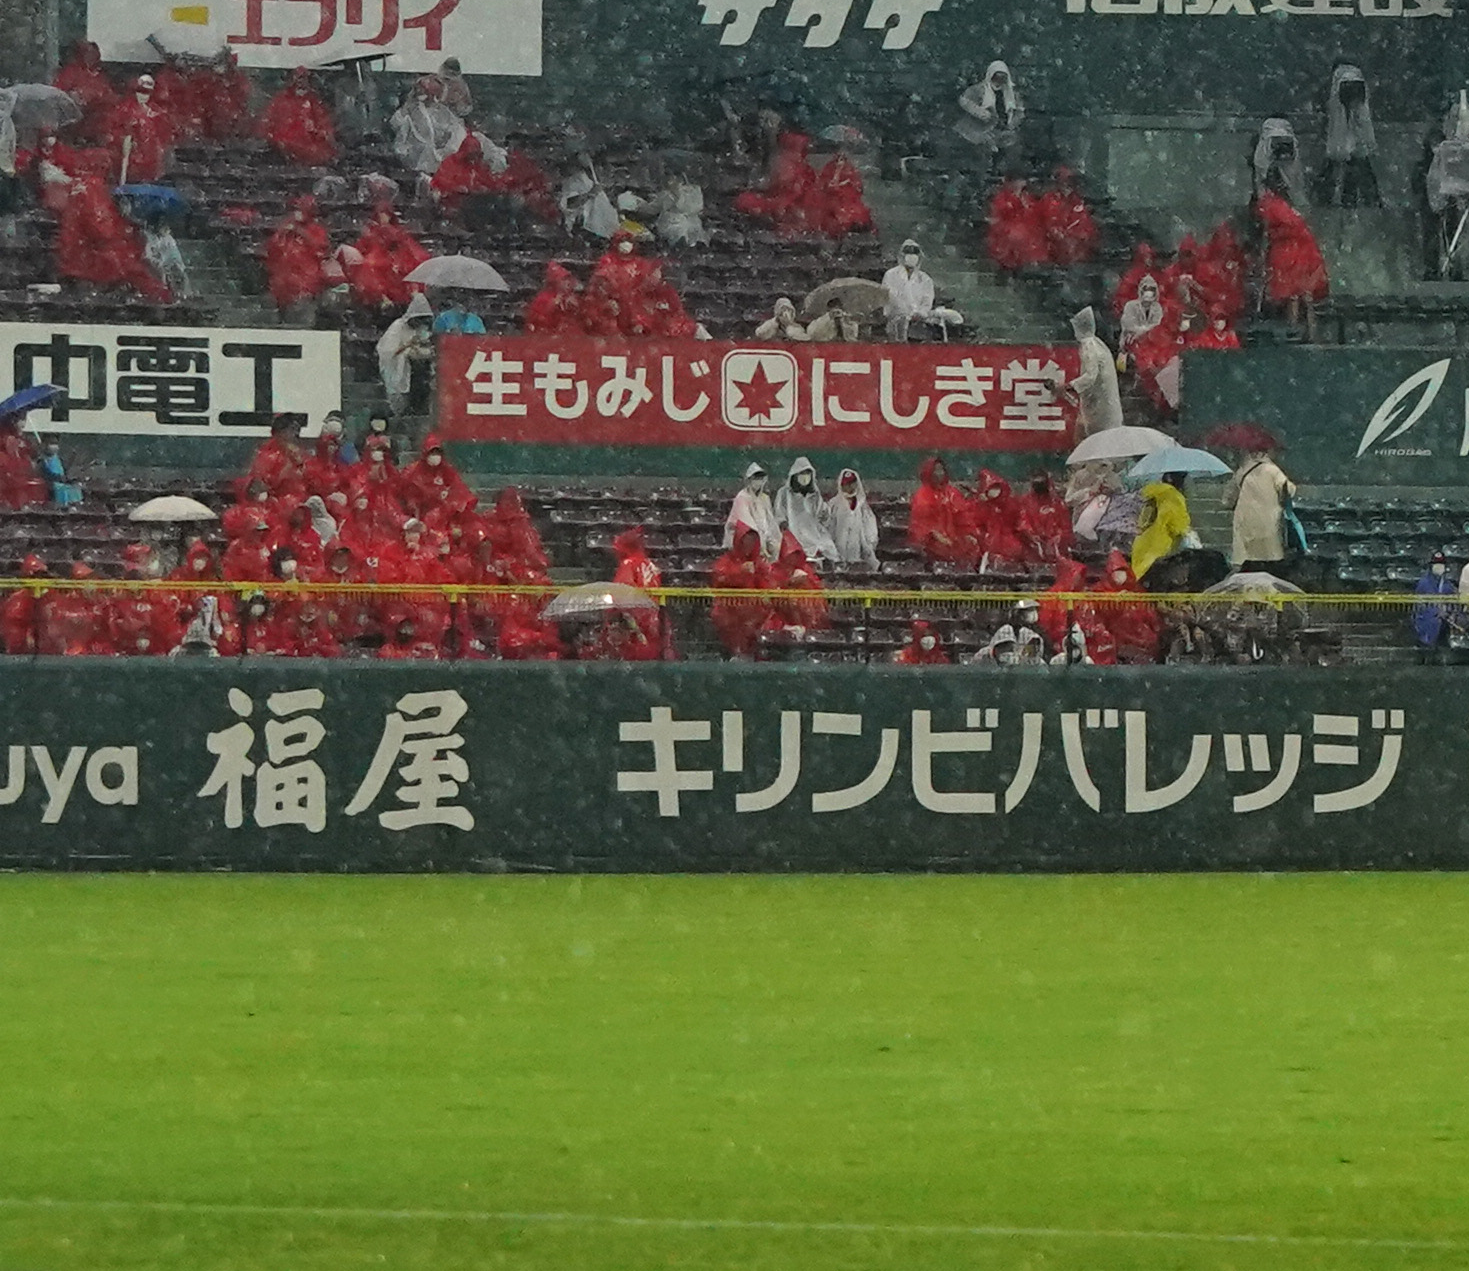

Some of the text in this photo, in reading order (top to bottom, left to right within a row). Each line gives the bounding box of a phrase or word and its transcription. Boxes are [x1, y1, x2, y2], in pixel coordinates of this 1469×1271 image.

[13, 334, 308, 426] 中電工
[465, 351, 711, 422] 生もみじ
[811, 359, 1067, 431] にしき堂
[198, 688, 475, 833] 福屋
[616, 706, 1404, 816] キリンビバレッジ
